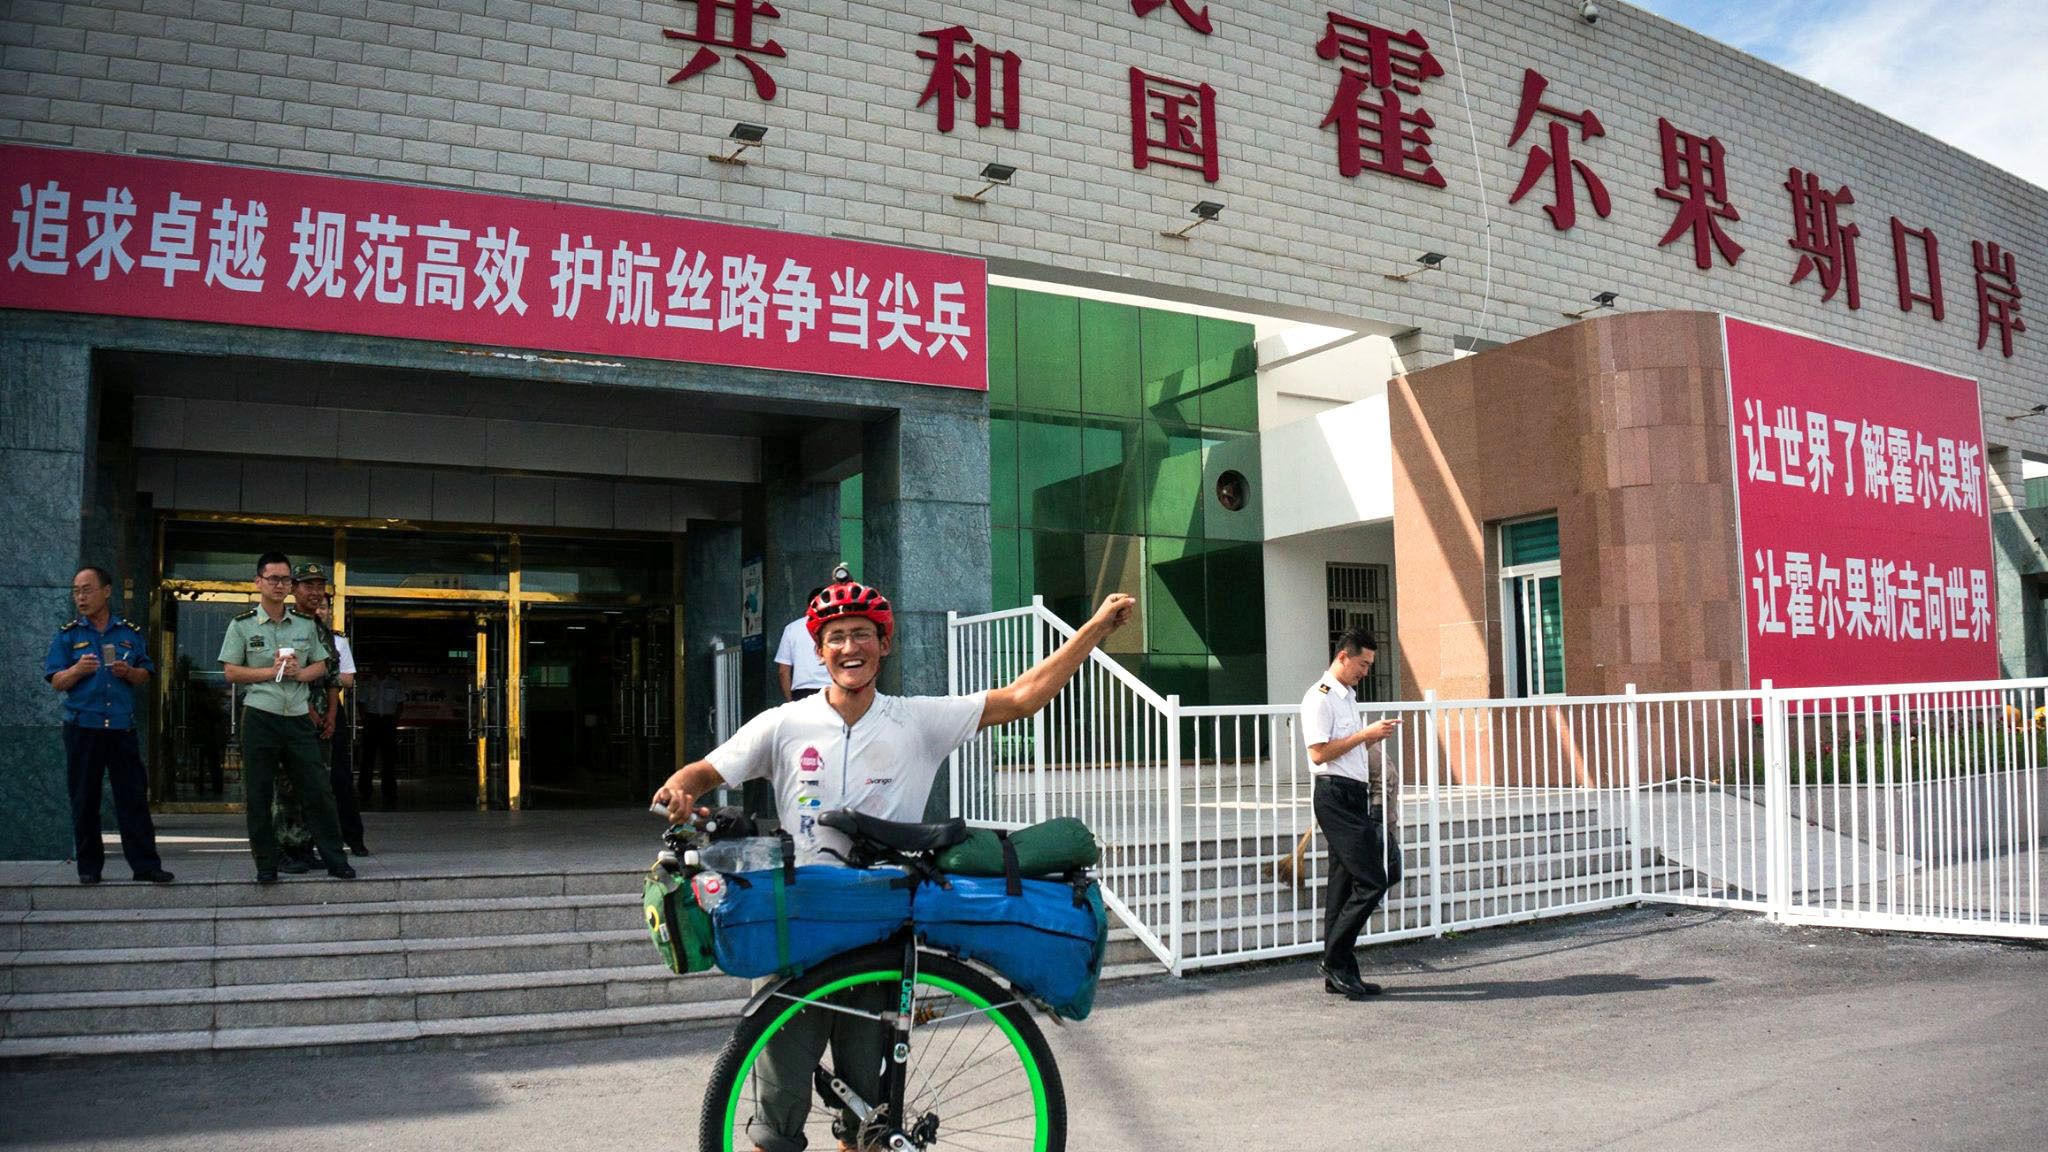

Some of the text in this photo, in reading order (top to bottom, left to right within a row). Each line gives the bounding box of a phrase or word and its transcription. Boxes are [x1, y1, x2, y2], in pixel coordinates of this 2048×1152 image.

[8, 180, 972, 361] 追求卓越 规范高效 护航丝路争当尖兵
[1742, 397, 1983, 517] 让世界了解霍尔果斯
[1752, 548, 1992, 642] 让霍尔果斯走向世界
